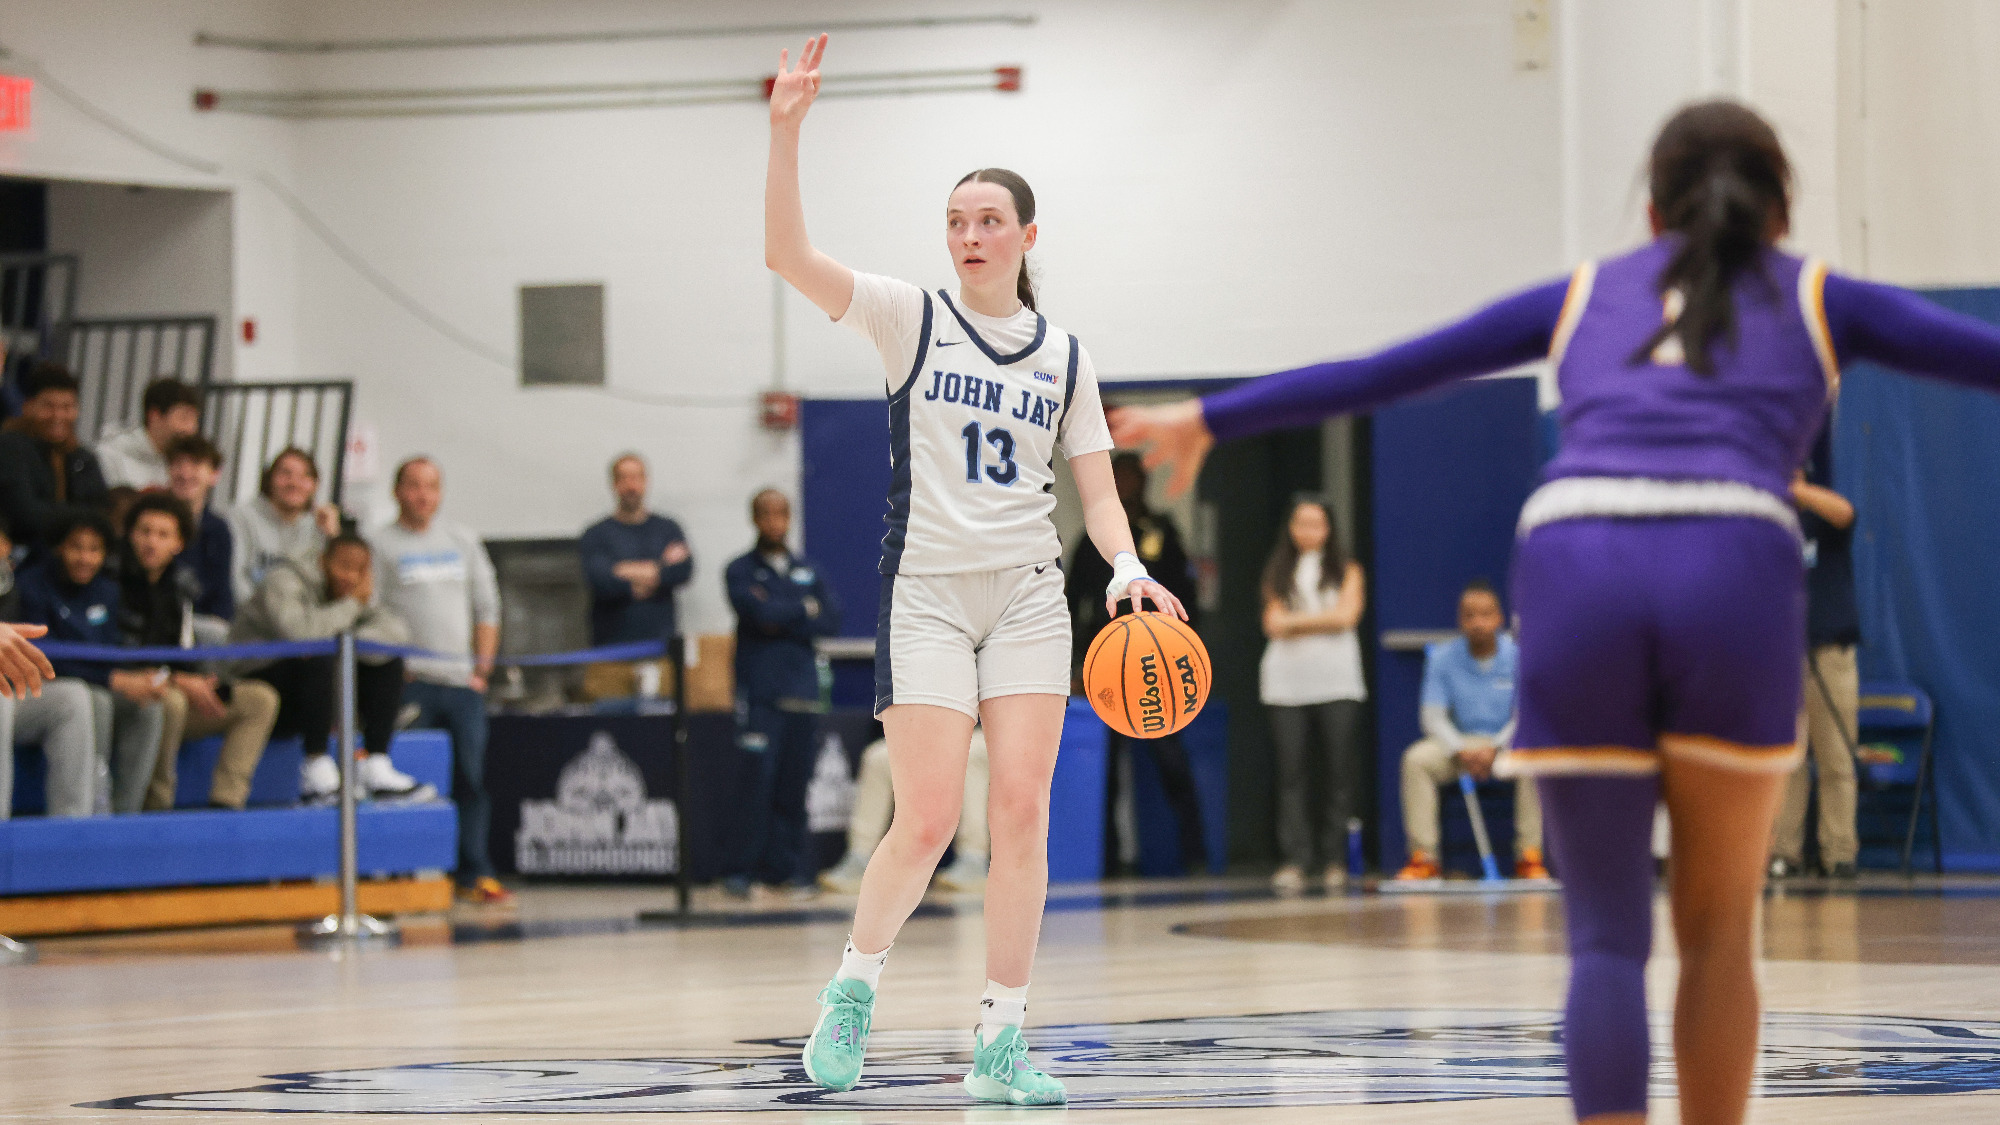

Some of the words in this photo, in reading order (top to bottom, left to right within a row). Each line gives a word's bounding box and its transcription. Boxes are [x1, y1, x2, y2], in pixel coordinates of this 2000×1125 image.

[924, 370, 1004, 413] JOHN
[1012, 389, 1060, 432] JAY
[1033, 370, 1059, 384] CUNY
[961, 419, 1020, 487] 13
[1138, 652, 1166, 733] Wilson
[1174, 653, 1198, 715] NCAA
